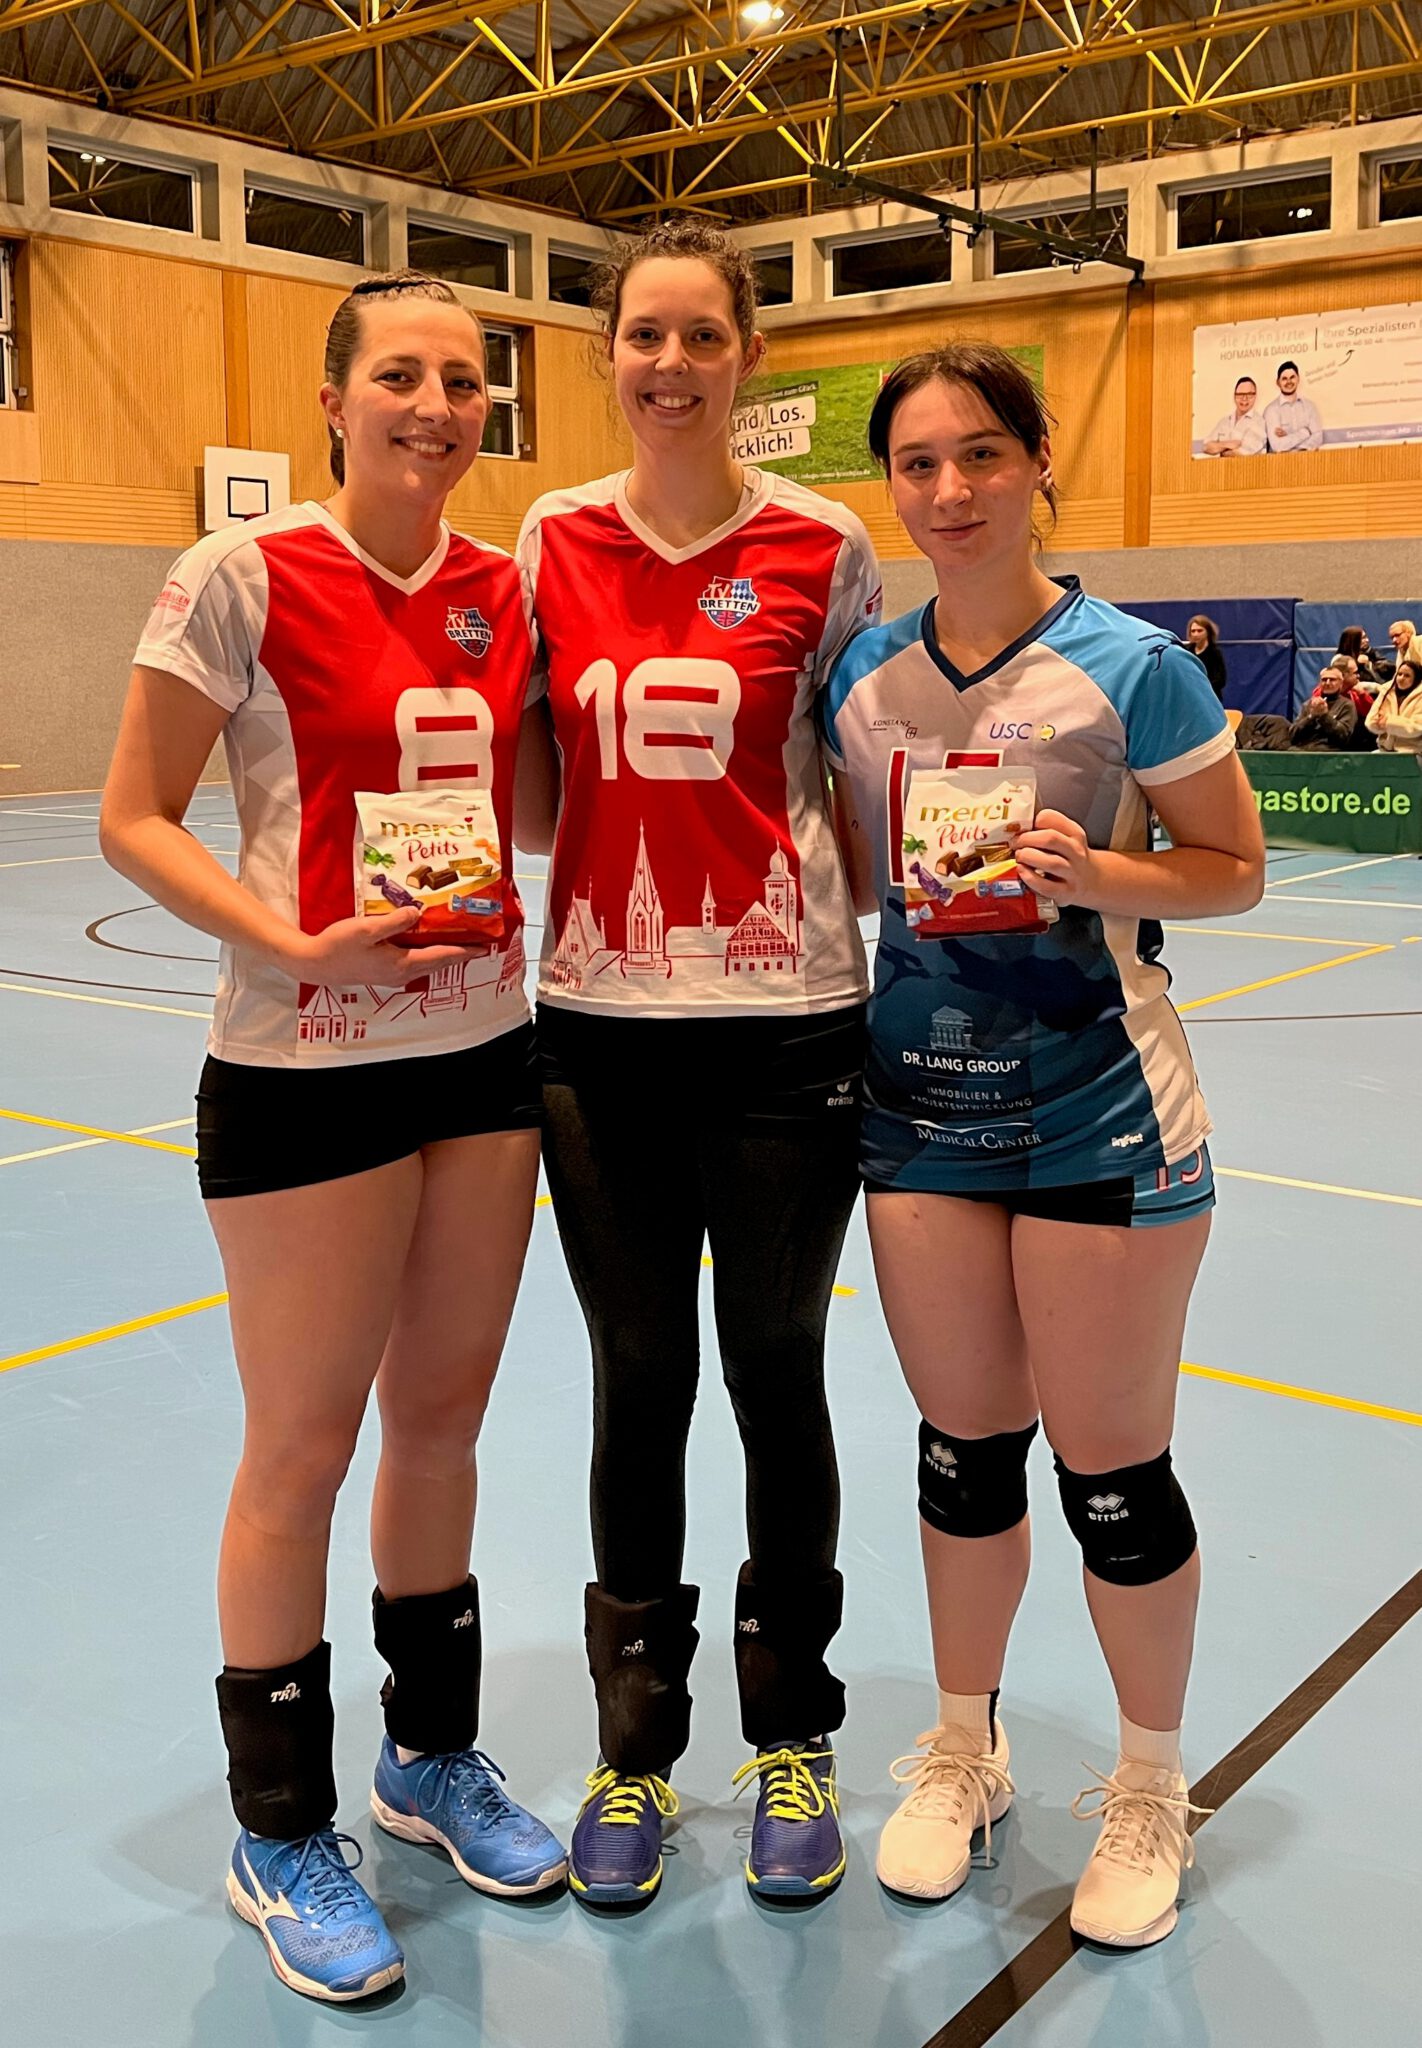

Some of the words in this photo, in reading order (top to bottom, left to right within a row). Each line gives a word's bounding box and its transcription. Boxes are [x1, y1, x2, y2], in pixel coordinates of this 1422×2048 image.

[1347, 320, 1417, 337] Spezialisten
[1219, 348, 1262, 361] HOFMANN
[1262, 347, 1269, 357] &
[1271, 343, 1309, 356] DAWOOD
[769, 406, 806, 425] Los.
[708, 583, 731, 600] TV
[699, 599, 758, 612] BRETTEN
[447, 612, 466, 629] TV
[447, 629, 491, 641] BRETTEN
[573, 657, 742, 781] 18
[873, 719, 912, 728] KONSTANZ
[394, 687, 495, 792] 8
[989, 722, 1033, 740] USC
[919, 797, 1013, 822] merci
[380, 816, 475, 838] merci
[935, 824, 989, 849] Petits
[400, 839, 460, 863] Petits
[902, 1050, 924, 1067] DR.
[926, 1054, 964, 1072] LANG
[966, 1060, 1021, 1073] GROUP
[926, 1087, 990, 1101] IMMOBILIEN
[993, 1091, 1002, 1101] &
[910, 1096, 1033, 1112] PROJEKTENTWICKLUNG
